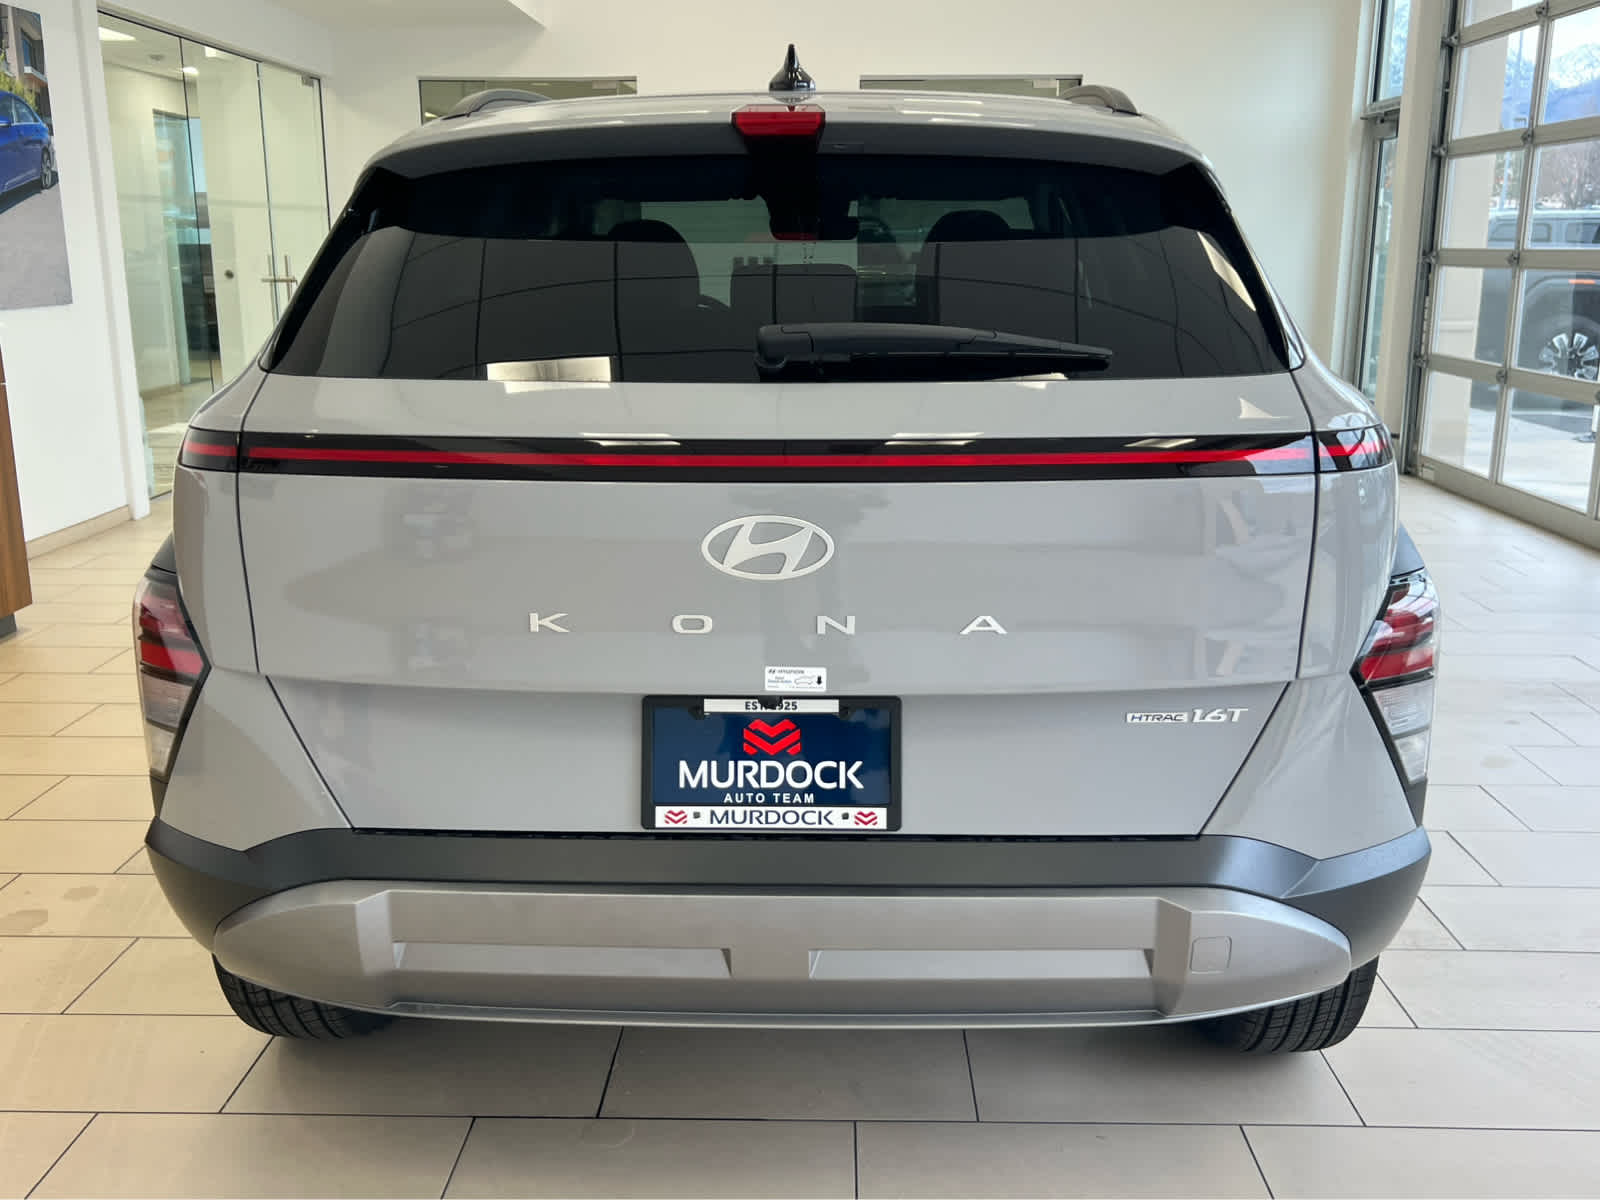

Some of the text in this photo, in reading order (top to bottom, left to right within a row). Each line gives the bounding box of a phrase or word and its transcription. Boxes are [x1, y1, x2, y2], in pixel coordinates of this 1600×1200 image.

[529, 612, 1008, 635] KONA
[1131, 714, 1184, 722] HTRAC
[679, 760, 864, 789] MURDOCK
[723, 793, 815, 804] AUTO TEAM
[709, 810, 834, 825] MURDOCK
